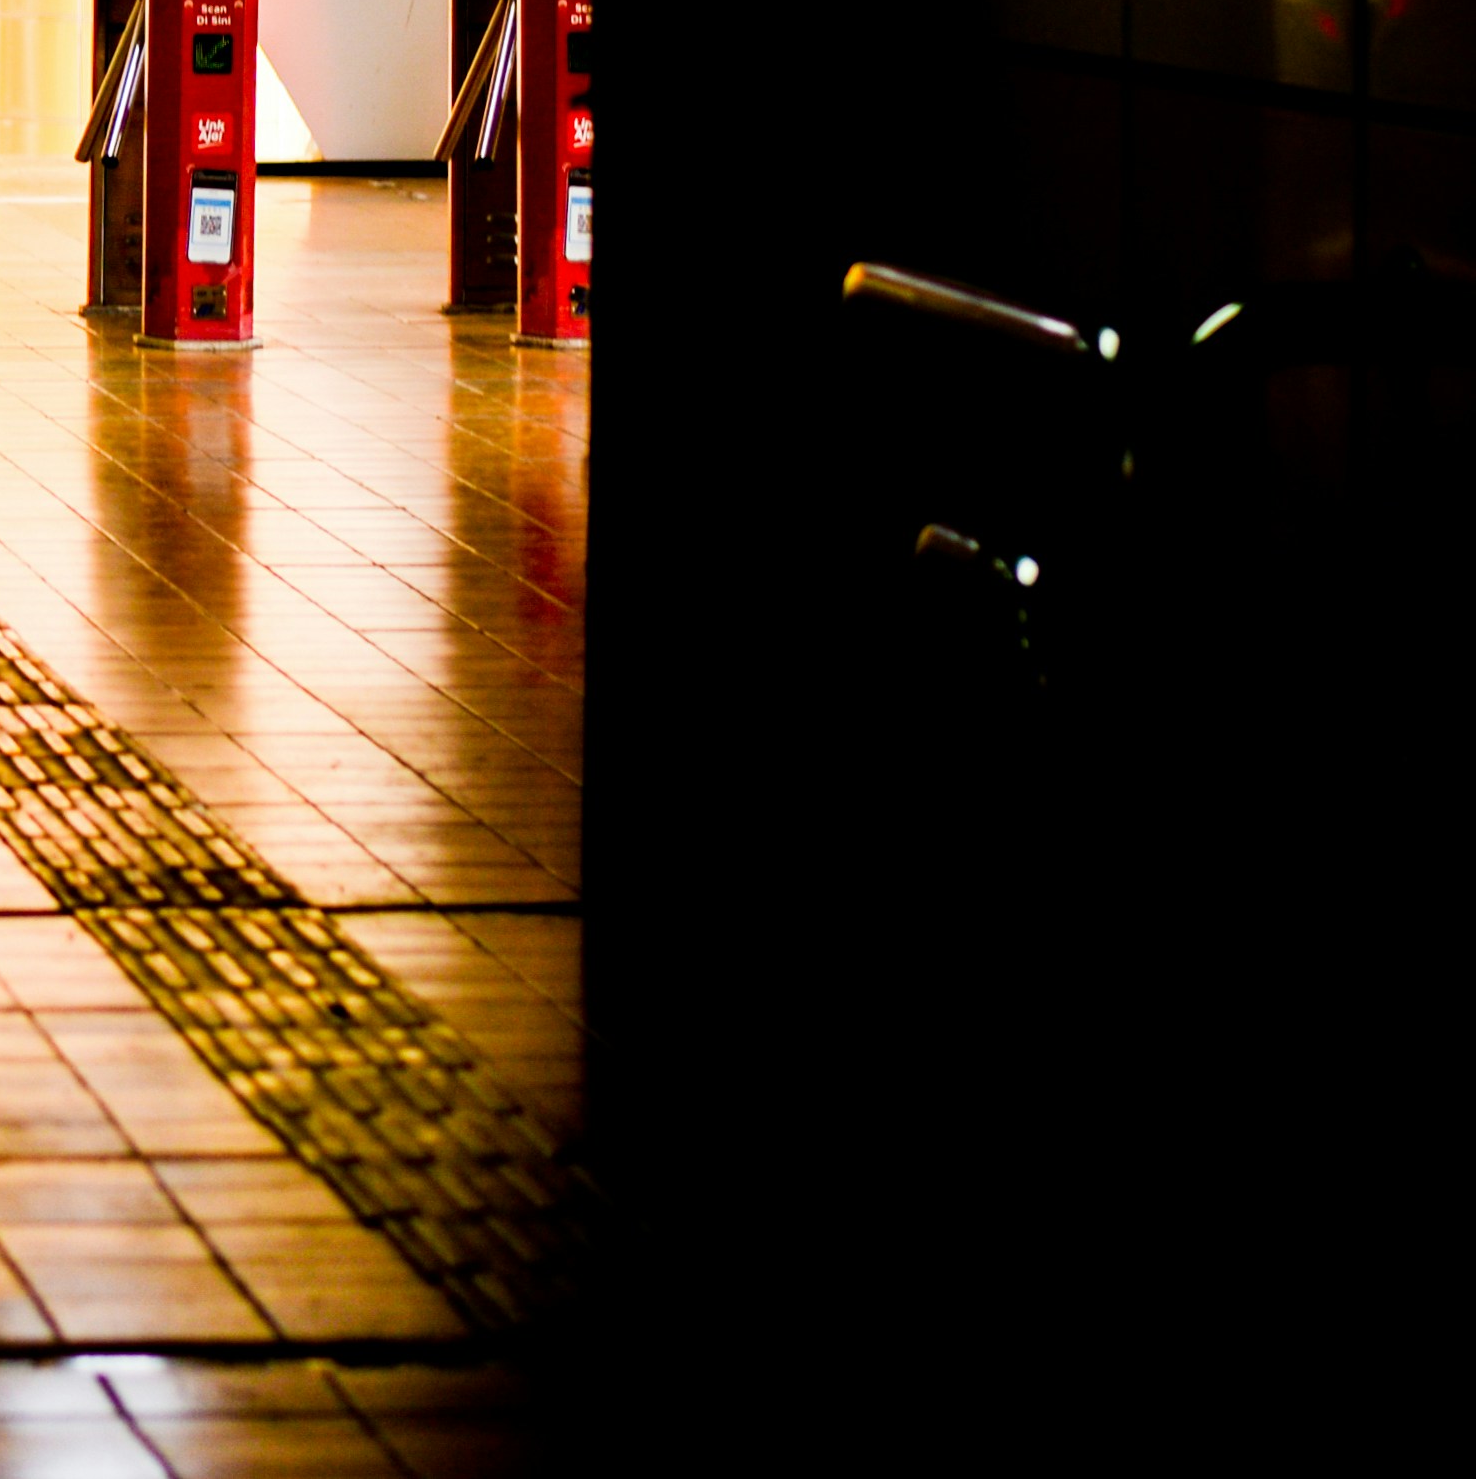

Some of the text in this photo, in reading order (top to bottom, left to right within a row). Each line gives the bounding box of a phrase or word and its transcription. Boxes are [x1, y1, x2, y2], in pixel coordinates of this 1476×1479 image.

[201, 3, 227, 15] Scan
[196, 15, 231, 26] Di Sini
[570, 14, 582, 25] Di
[198, 118, 225, 132] Link
[573, 117, 593, 130] Lin
